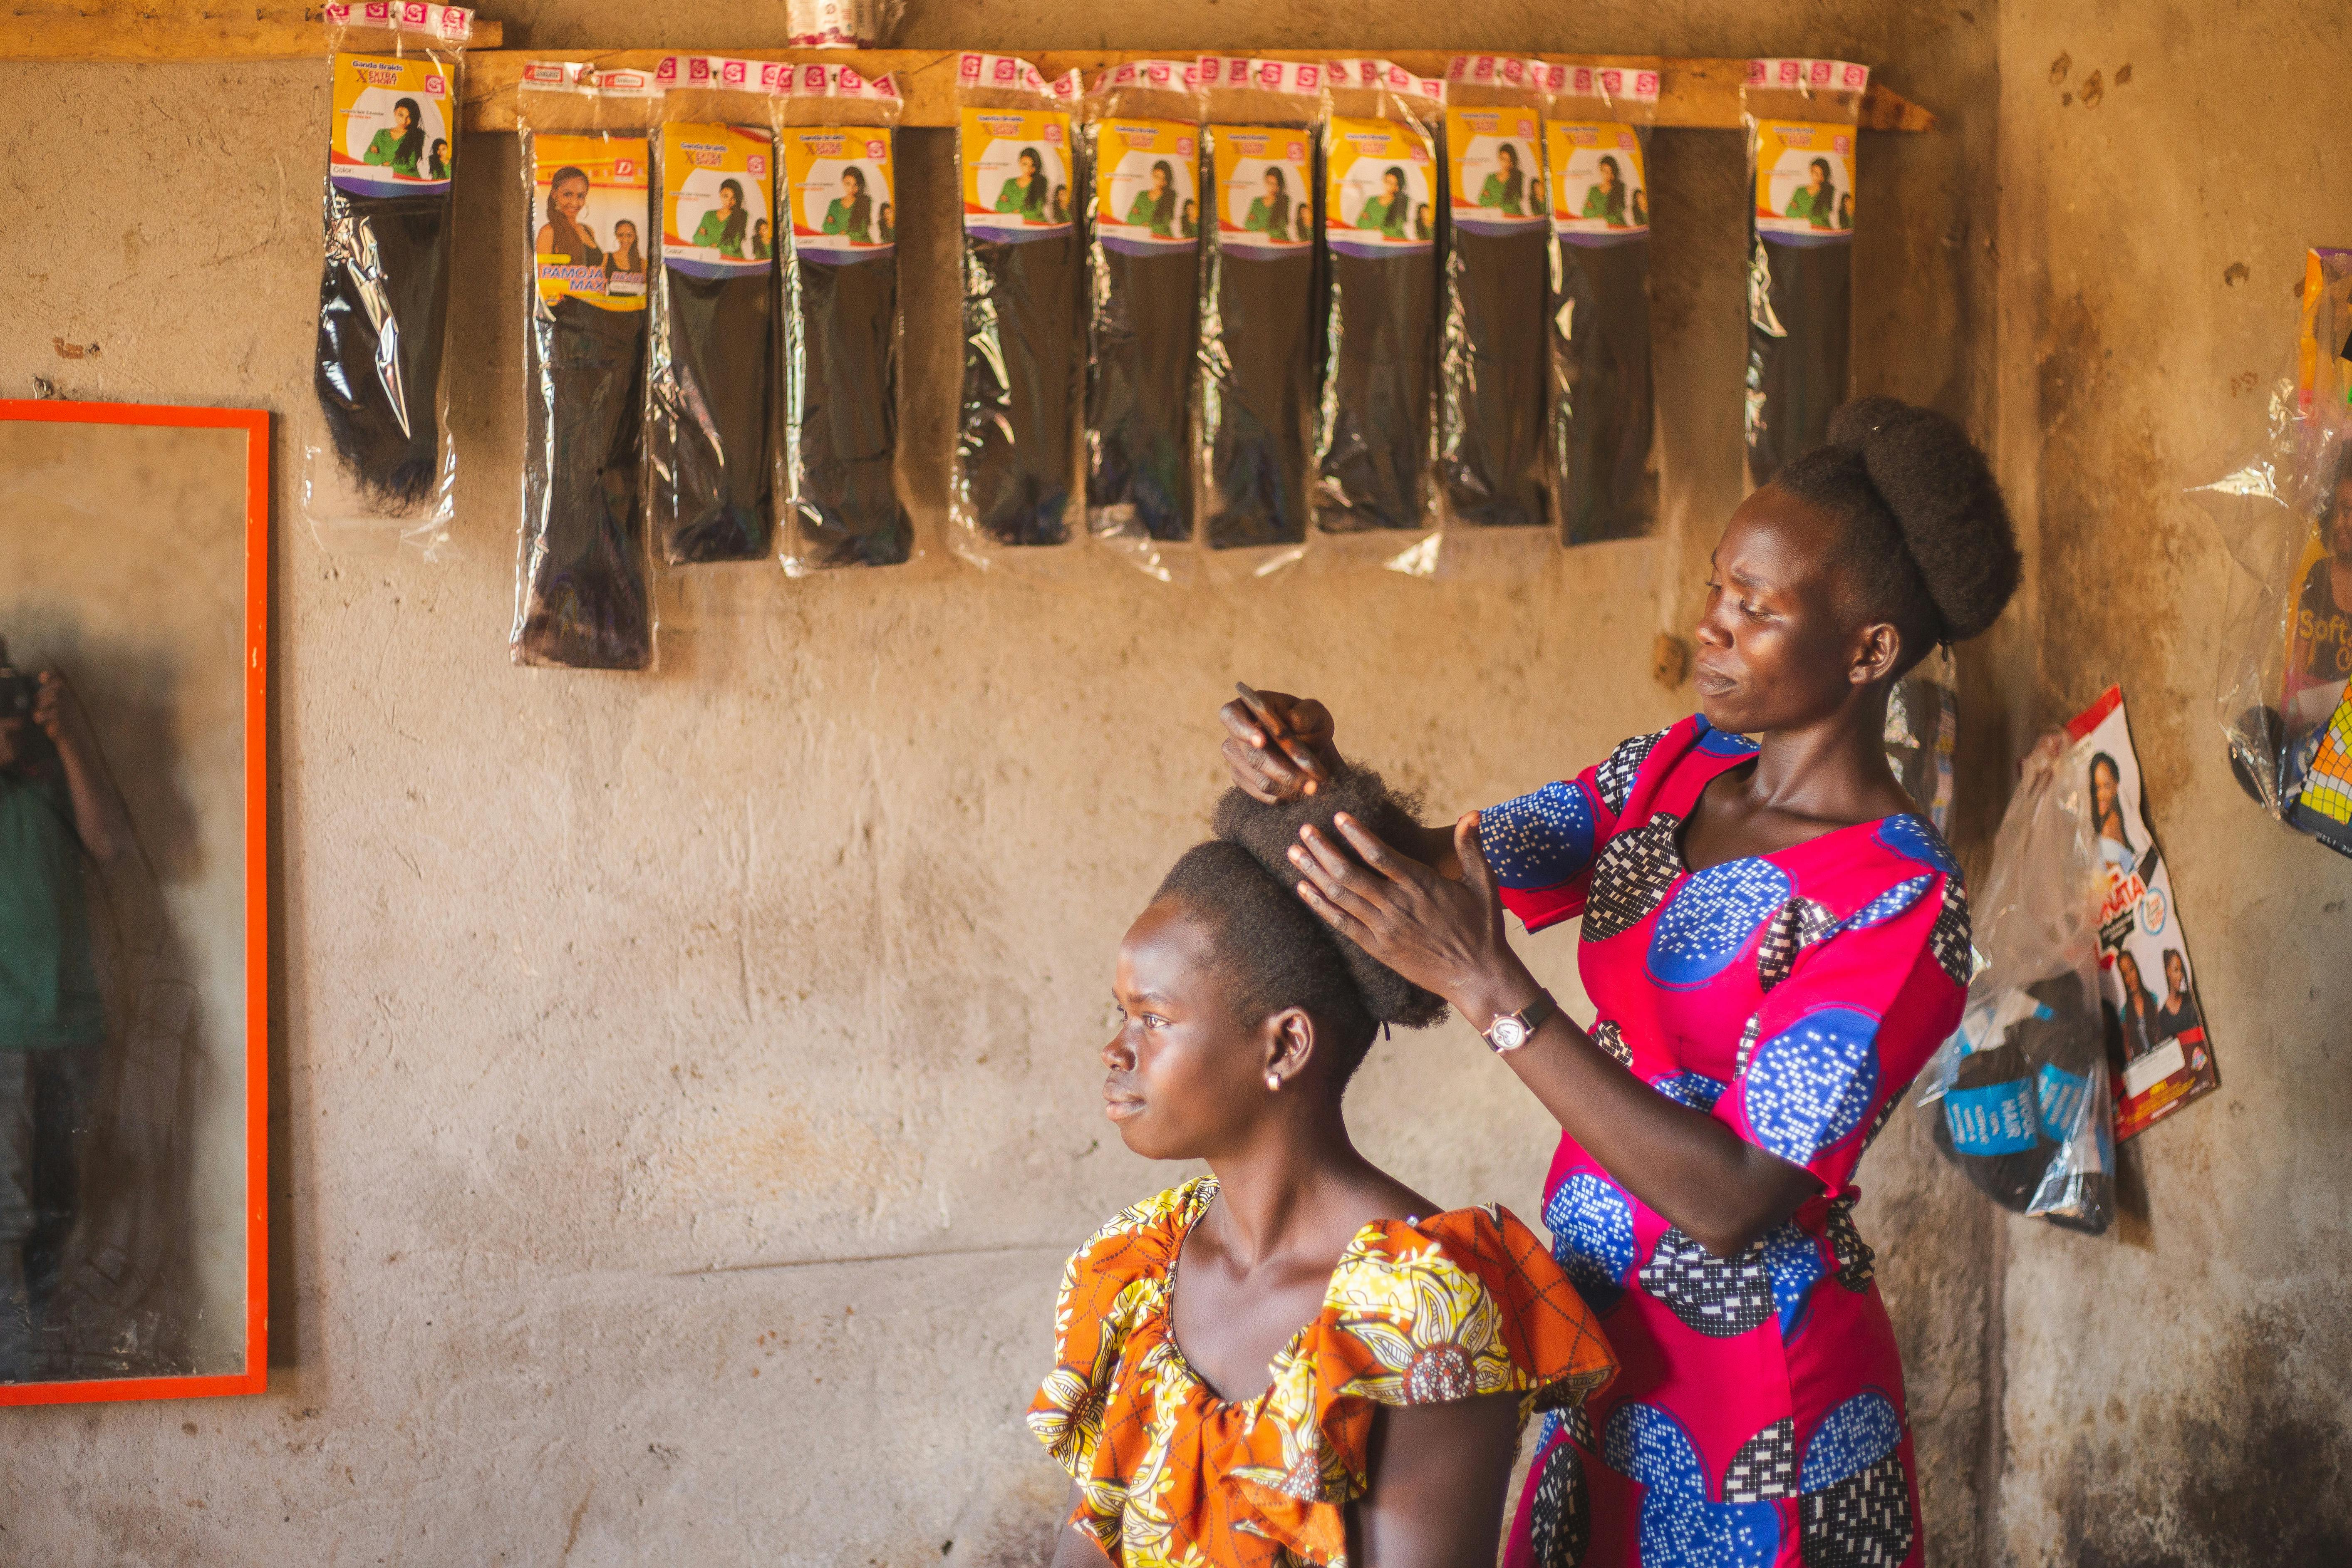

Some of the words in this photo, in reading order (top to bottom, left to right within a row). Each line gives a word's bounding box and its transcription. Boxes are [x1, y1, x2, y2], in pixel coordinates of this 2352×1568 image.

[352, 60, 377, 69] Ganda
[379, 63, 403, 72] Braids
[357, 69, 369, 83] X
[369, 70, 397, 79] EXTRA
[368, 77, 397, 85] SHORT
[542, 267, 603, 280] PAMOJA
[570, 279, 604, 292] MAX
[2299, 609, 2348, 644] Soft
